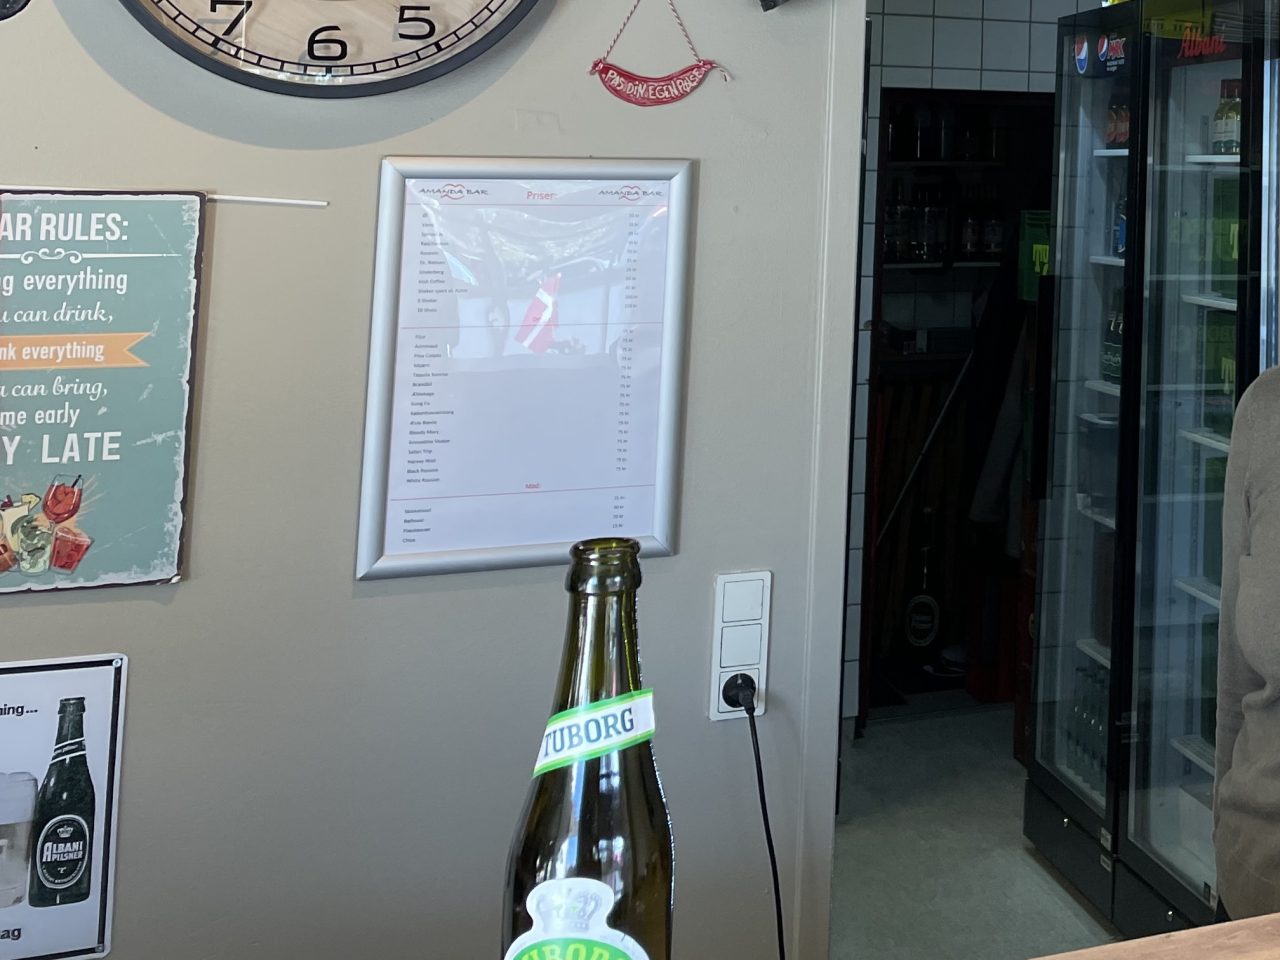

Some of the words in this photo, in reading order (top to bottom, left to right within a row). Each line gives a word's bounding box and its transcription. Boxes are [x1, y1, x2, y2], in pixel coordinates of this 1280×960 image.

[209, 0, 253, 37] 7
[398, 5, 436, 41] 5
[307, 26, 348, 62] 6
[605, 70, 624, 90] PAS
[650, 81, 679, 99] EGEN
[677, 68, 703, 93] PØLSE
[40, 210, 129, 242] RULES:
[23, 266, 128, 295] everything
[14, 307, 50, 322] can
[53, 301, 114, 326] drink,
[22, 342, 105, 363] everything
[12, 384, 48, 398] can
[52, 376, 108, 401] bring,
[34, 402, 81, 429] early
[41, 431, 122, 464] LATE
[544, 707, 634, 758] TUBORG
[42, 840, 83, 861] ALBANI
